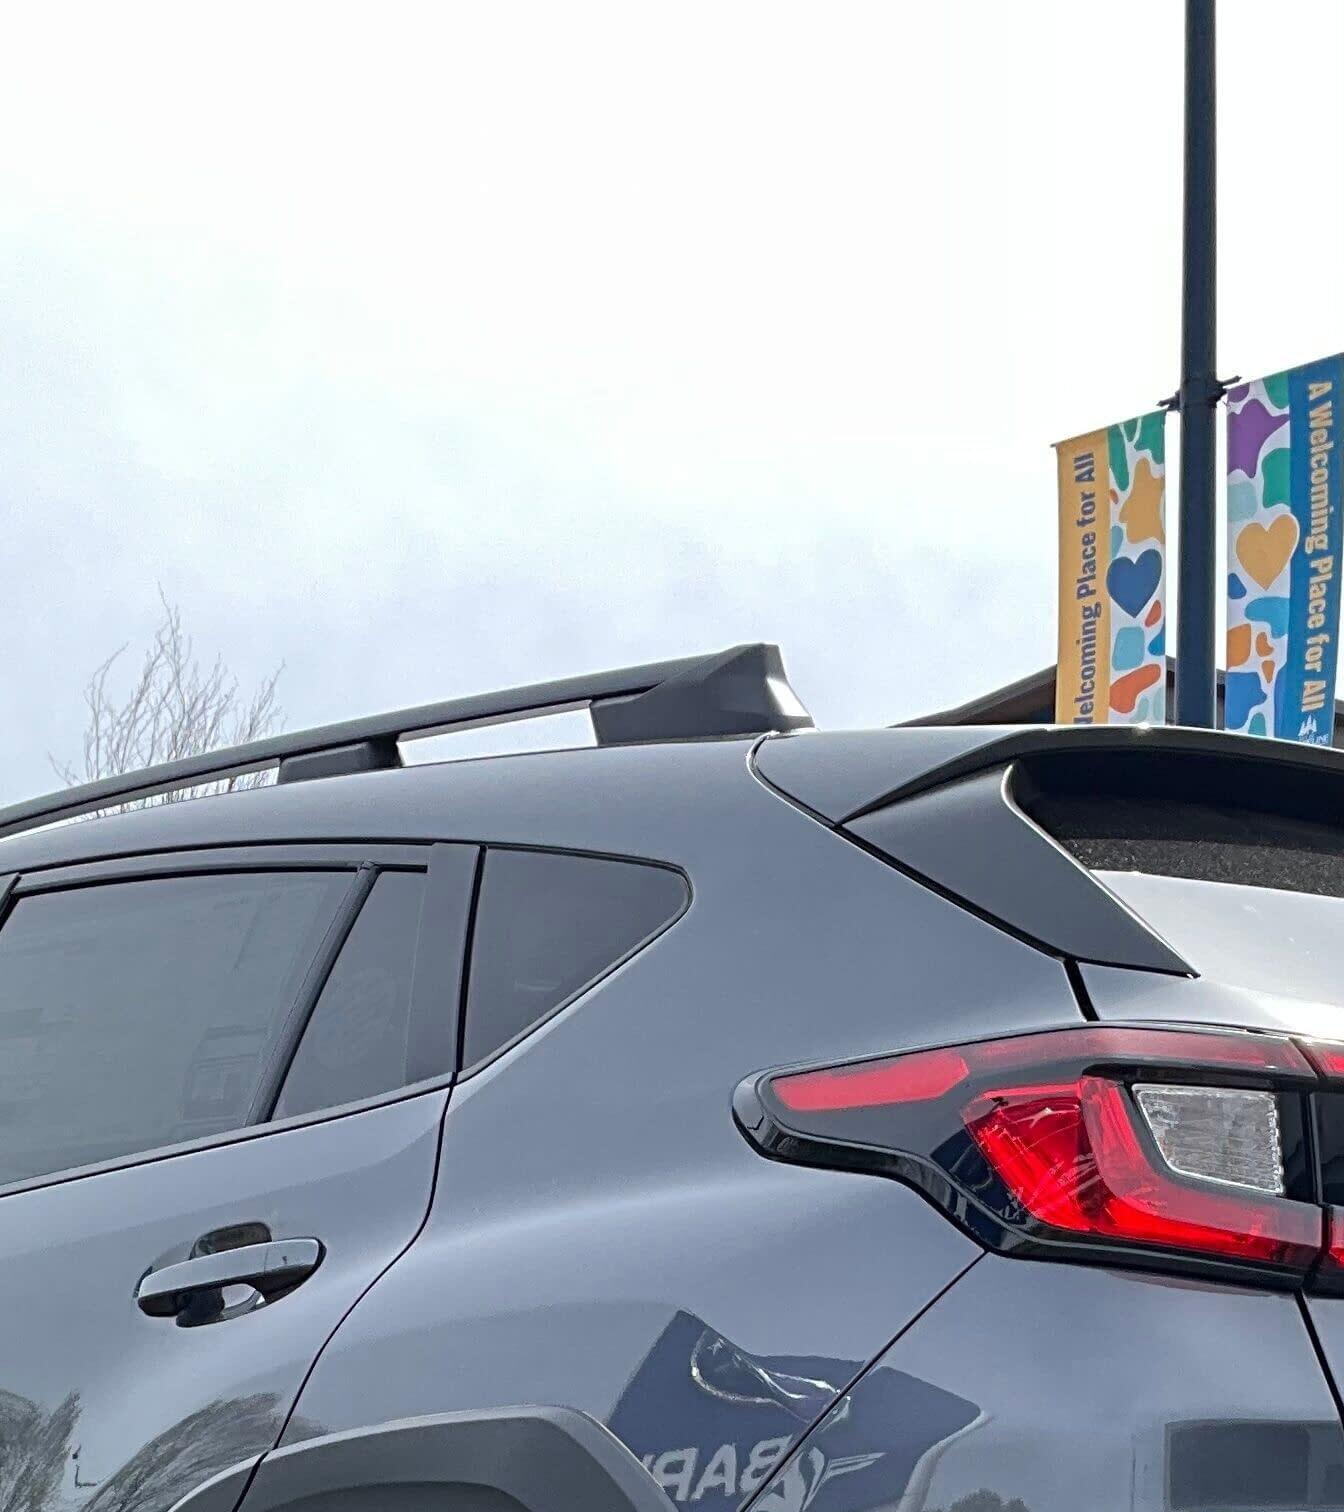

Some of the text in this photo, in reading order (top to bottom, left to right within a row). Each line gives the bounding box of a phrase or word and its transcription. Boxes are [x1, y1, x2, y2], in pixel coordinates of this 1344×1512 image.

[1309, 381, 1333, 401] A
[1073, 452, 1096, 483] All
[1304, 400, 1335, 554] Welcoming
[1076, 491, 1096, 528] for
[1076, 531, 1097, 600] Place
[1306, 555, 1334, 630] Place
[1304, 633, 1331, 673] for
[1301, 680, 1327, 713] All
